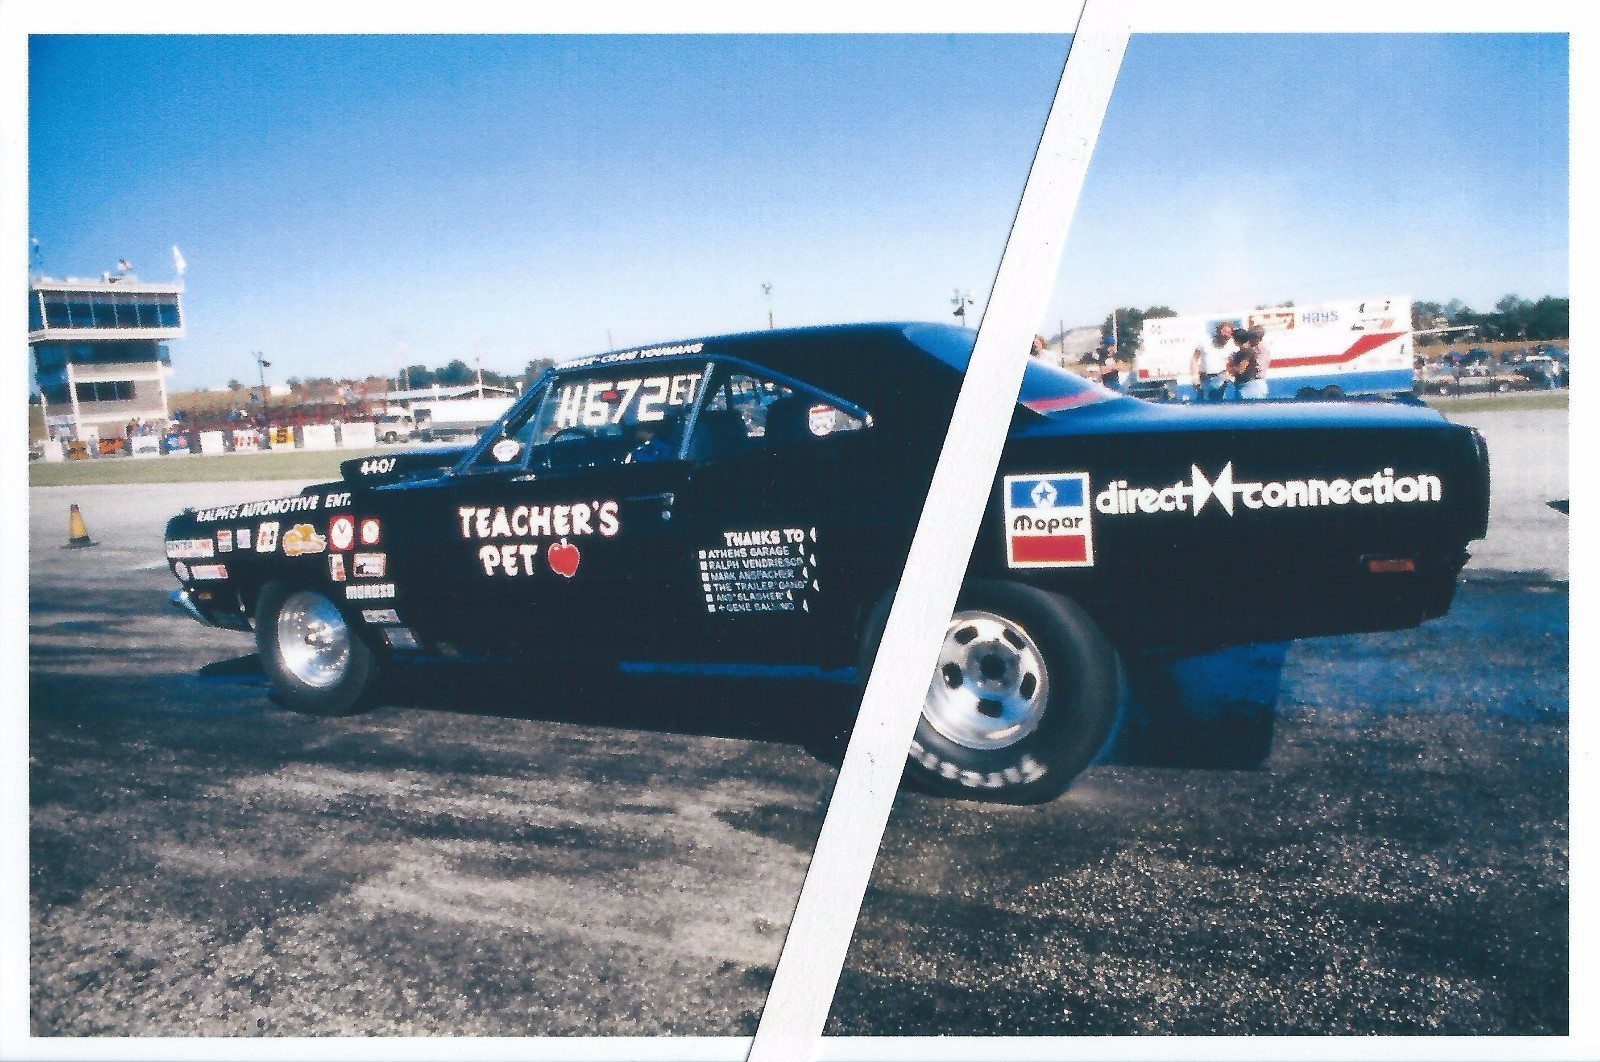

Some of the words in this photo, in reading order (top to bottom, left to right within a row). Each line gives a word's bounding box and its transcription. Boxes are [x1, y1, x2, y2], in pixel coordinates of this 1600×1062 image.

[669, 373, 702, 405] ET
[1096, 480, 1188, 515] direct
[1239, 466, 1442, 509] connection
[240, 496, 319, 517] AUTOMOTIVE
[324, 492, 351, 508] ENT.
[457, 500, 619, 538] TEACHER'S
[1014, 514, 1083, 533] Mopar
[723, 530, 781, 547] THANKS
[783, 528, 805, 543] TO
[478, 543, 539, 577] PET
[708, 547, 748, 559] ATHENS
[749, 546, 790, 557] GARAGE
[709, 559, 740, 570] RALPH
[713, 582, 733, 592] THE
